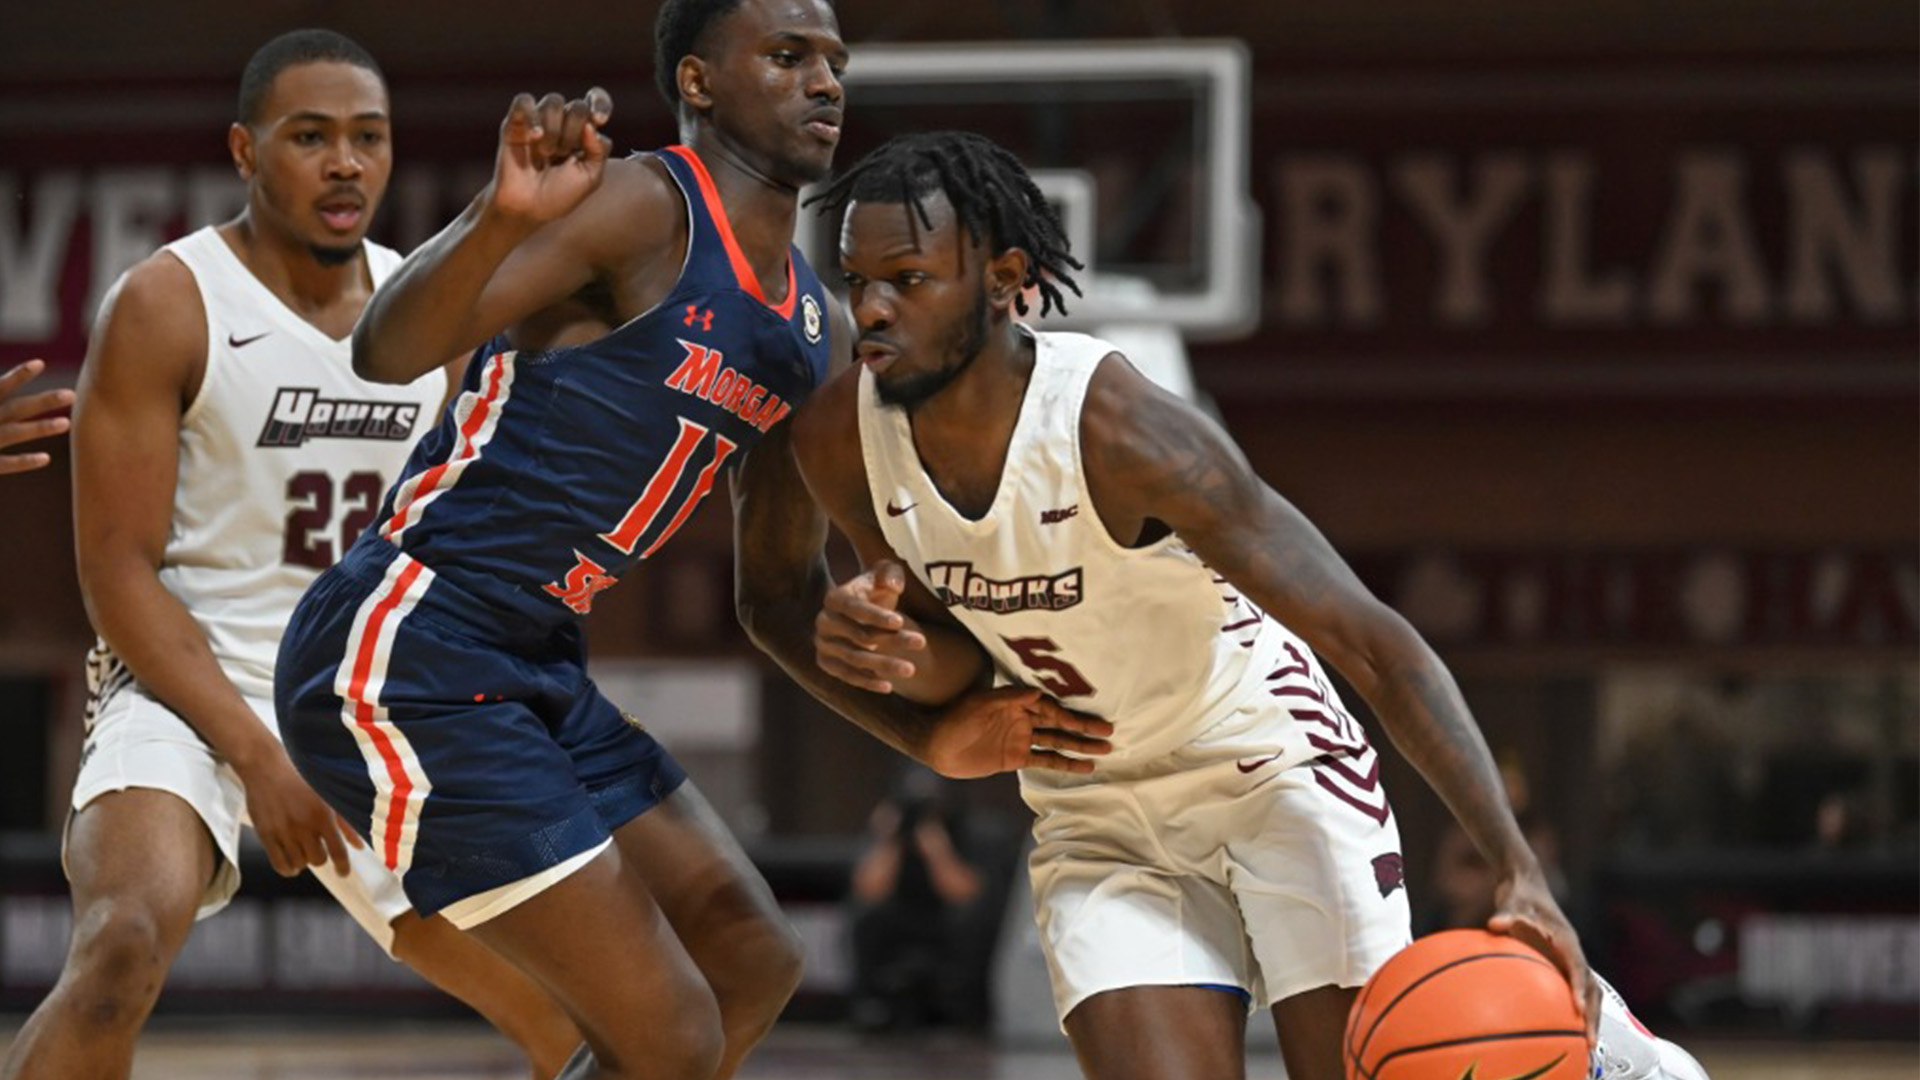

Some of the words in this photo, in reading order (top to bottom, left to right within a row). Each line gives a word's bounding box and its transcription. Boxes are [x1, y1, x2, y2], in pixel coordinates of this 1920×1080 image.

[256, 387, 421, 447] HAWKS
[597, 415, 738, 560] 11
[279, 468, 385, 573] 22
[925, 561, 1083, 615] HAWKS
[997, 633, 1098, 698] 5
